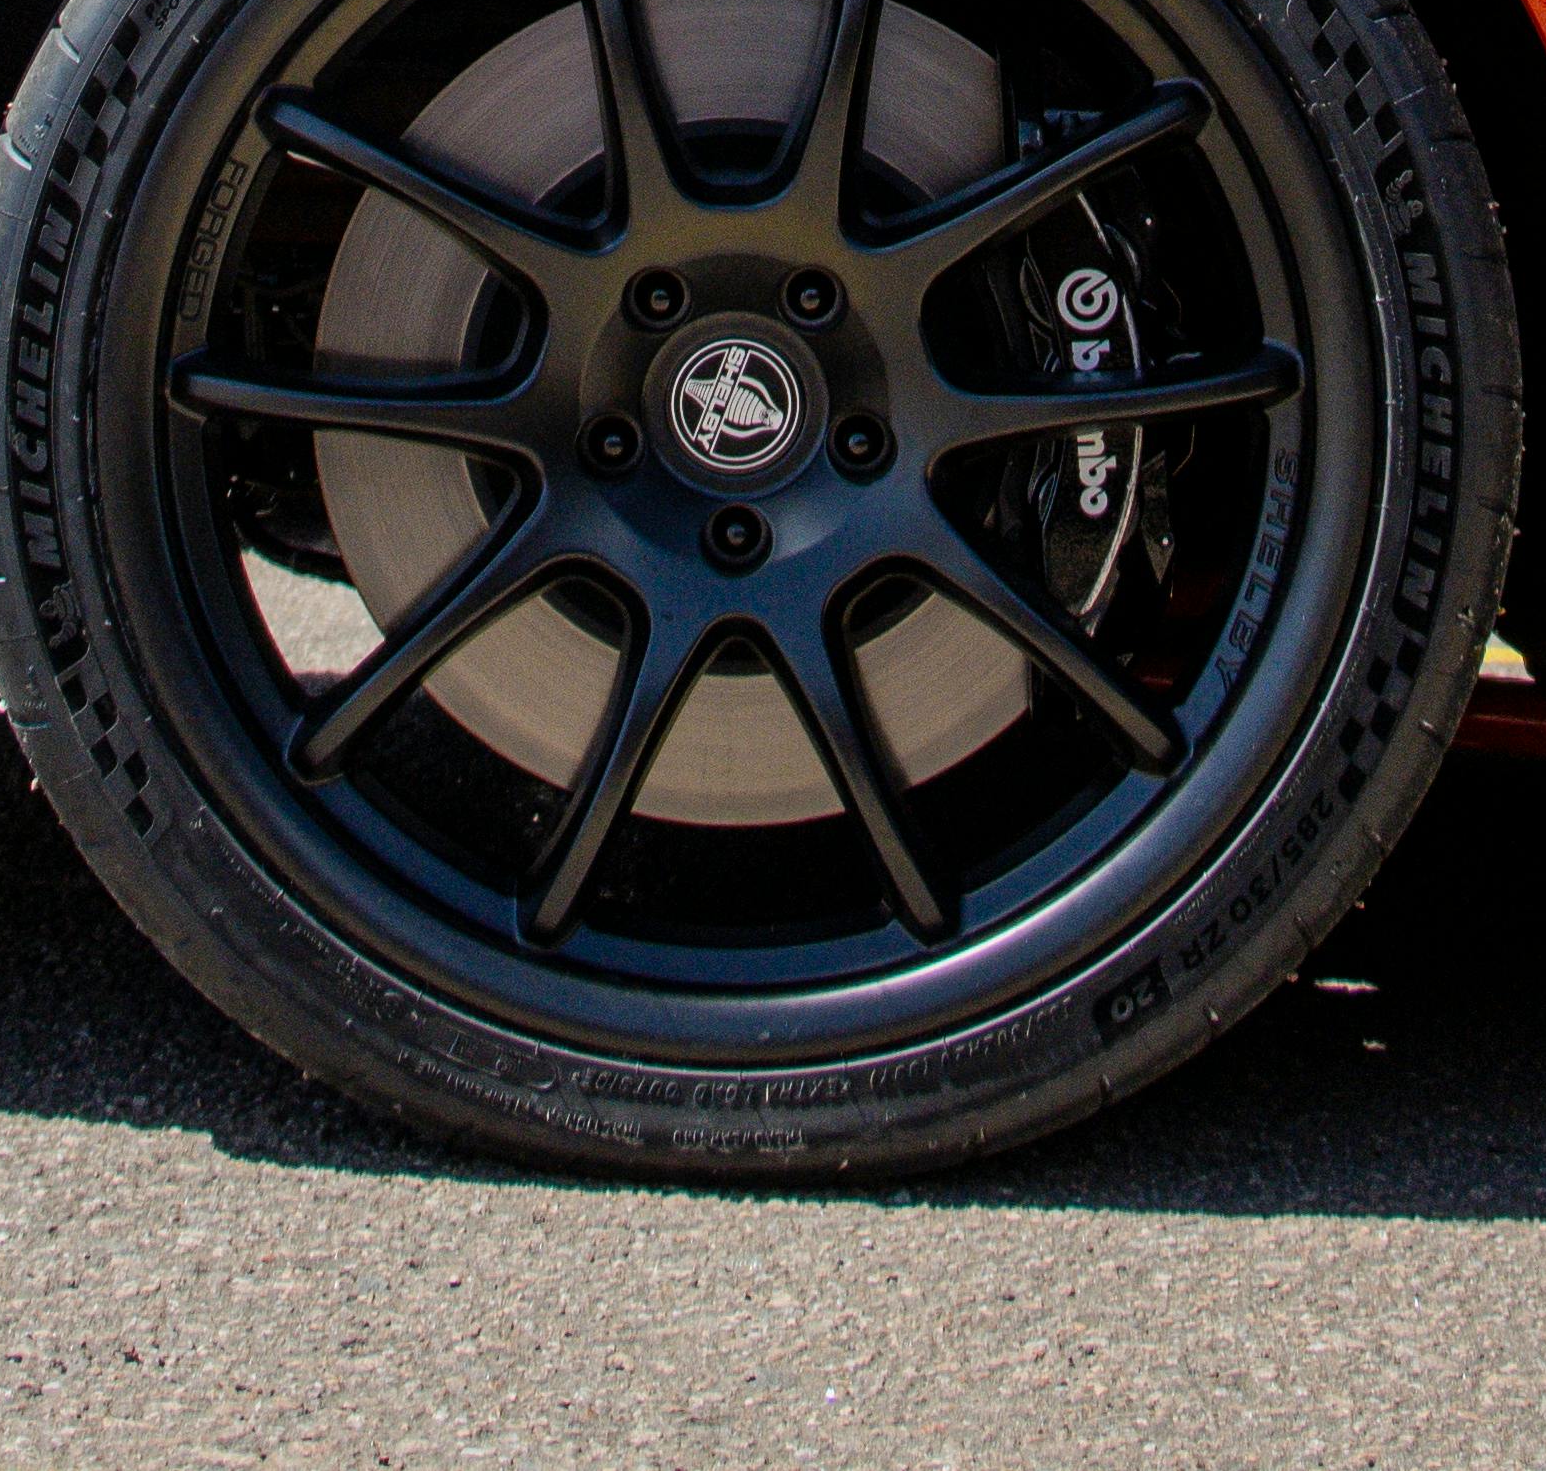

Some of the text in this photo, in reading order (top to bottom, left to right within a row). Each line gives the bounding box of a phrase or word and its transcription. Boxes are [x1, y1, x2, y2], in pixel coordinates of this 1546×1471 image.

[176, 158, 250, 326] FORGED
[13, 201, 78, 573] MICHELIN
[696, 345, 746, 452] SHELBY
[1389, 245, 1455, 610] MICHELIN
[1214, 448, 1304, 692] SHELBY
[1103, 974, 1162, 1025] 20
